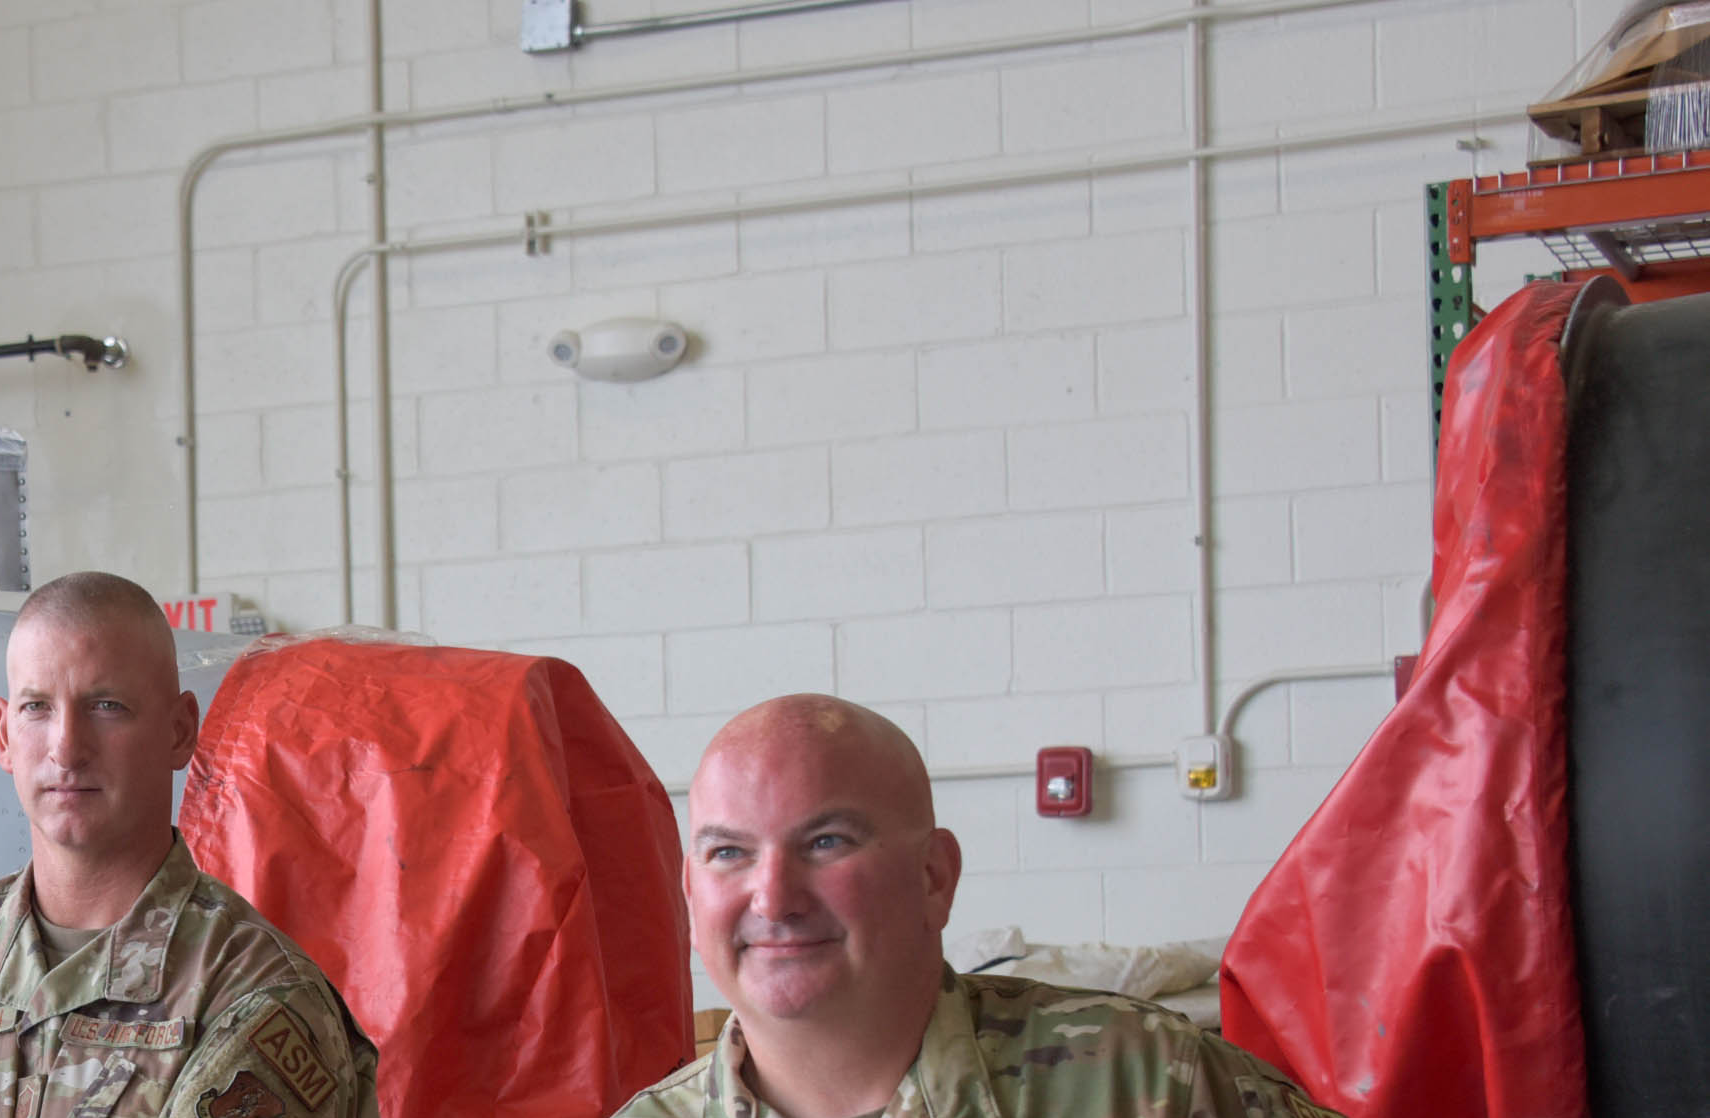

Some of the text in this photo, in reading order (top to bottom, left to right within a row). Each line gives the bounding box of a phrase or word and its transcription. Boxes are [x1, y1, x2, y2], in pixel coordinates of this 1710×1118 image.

[163, 598, 218, 632] XIT
[71, 1018, 180, 1047] U.S. AIR FORCE
[260, 1027, 329, 1099] ASM
